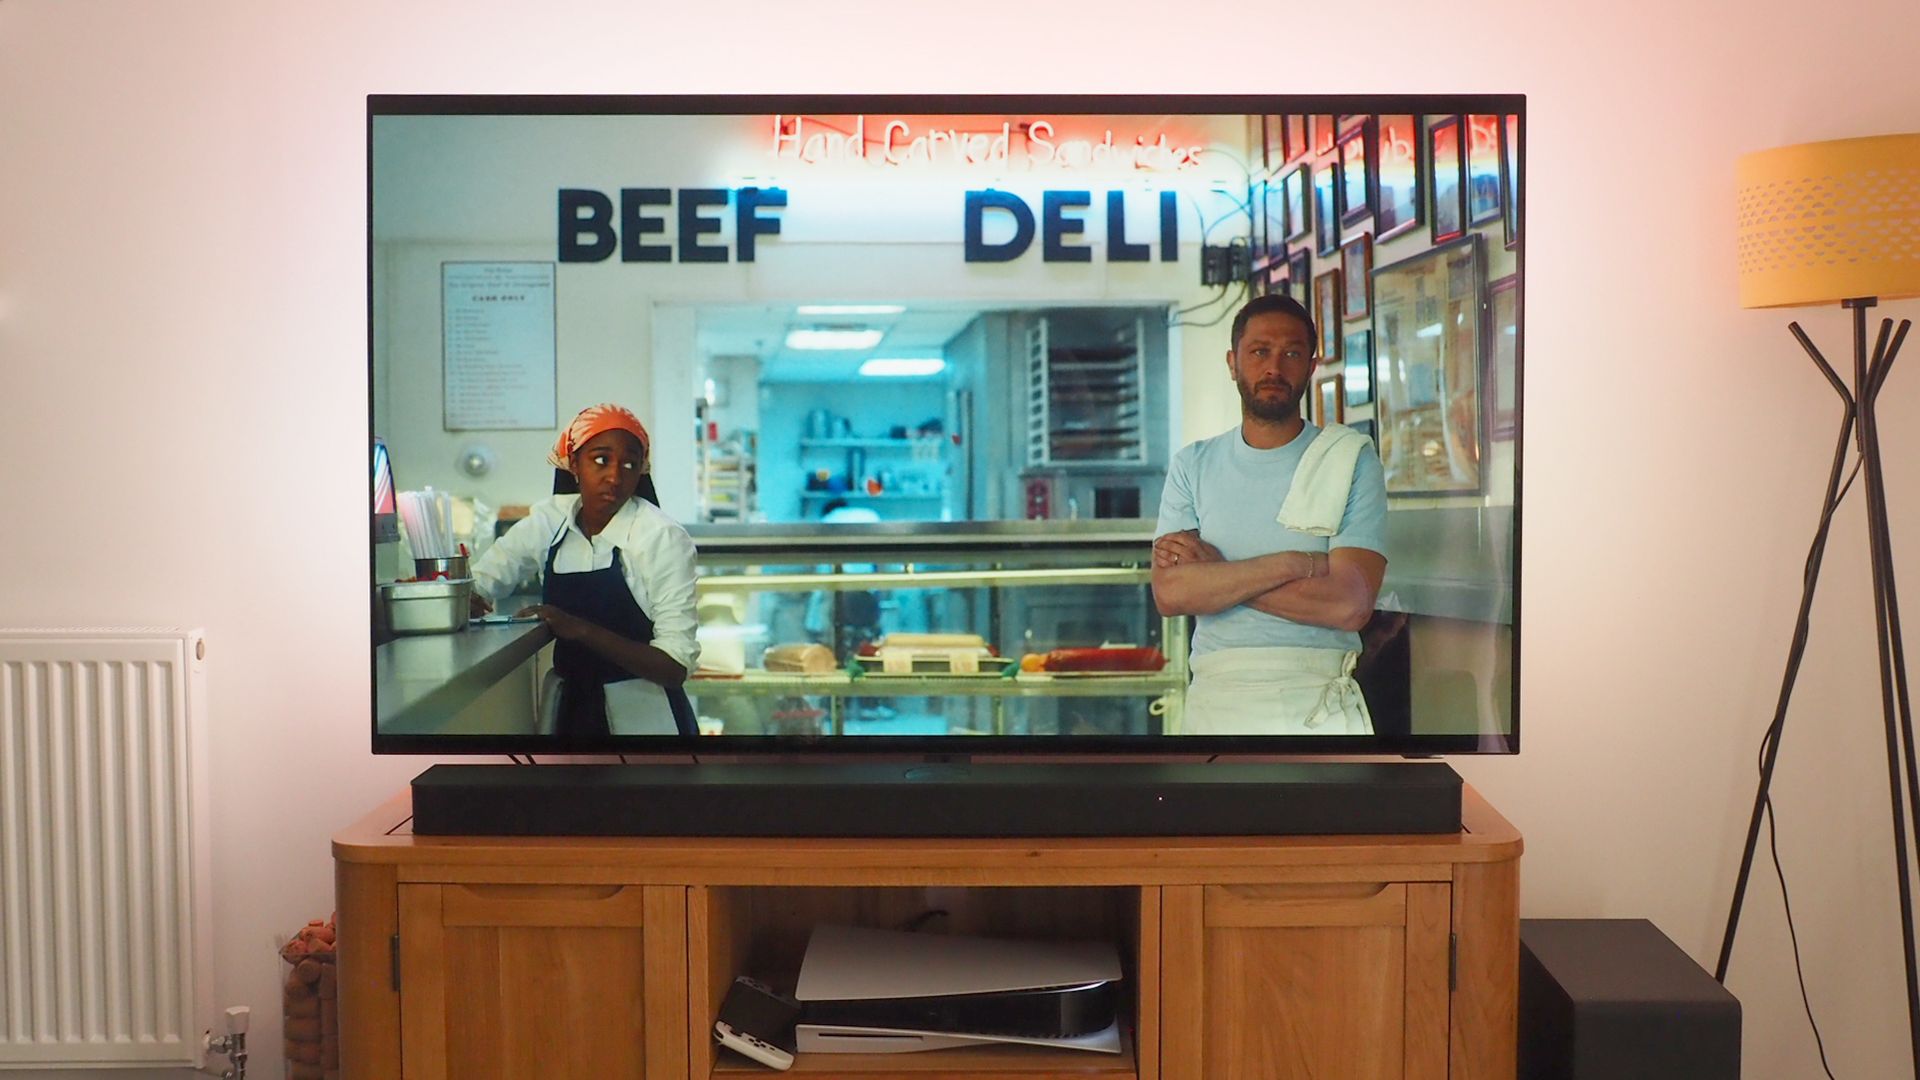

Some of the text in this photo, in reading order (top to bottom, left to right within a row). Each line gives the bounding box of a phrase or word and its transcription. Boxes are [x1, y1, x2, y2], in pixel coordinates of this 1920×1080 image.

[772, 114, 1203, 170] Hand Carved Sandwiches
[558, 188, 1179, 263] BEEF DELI
